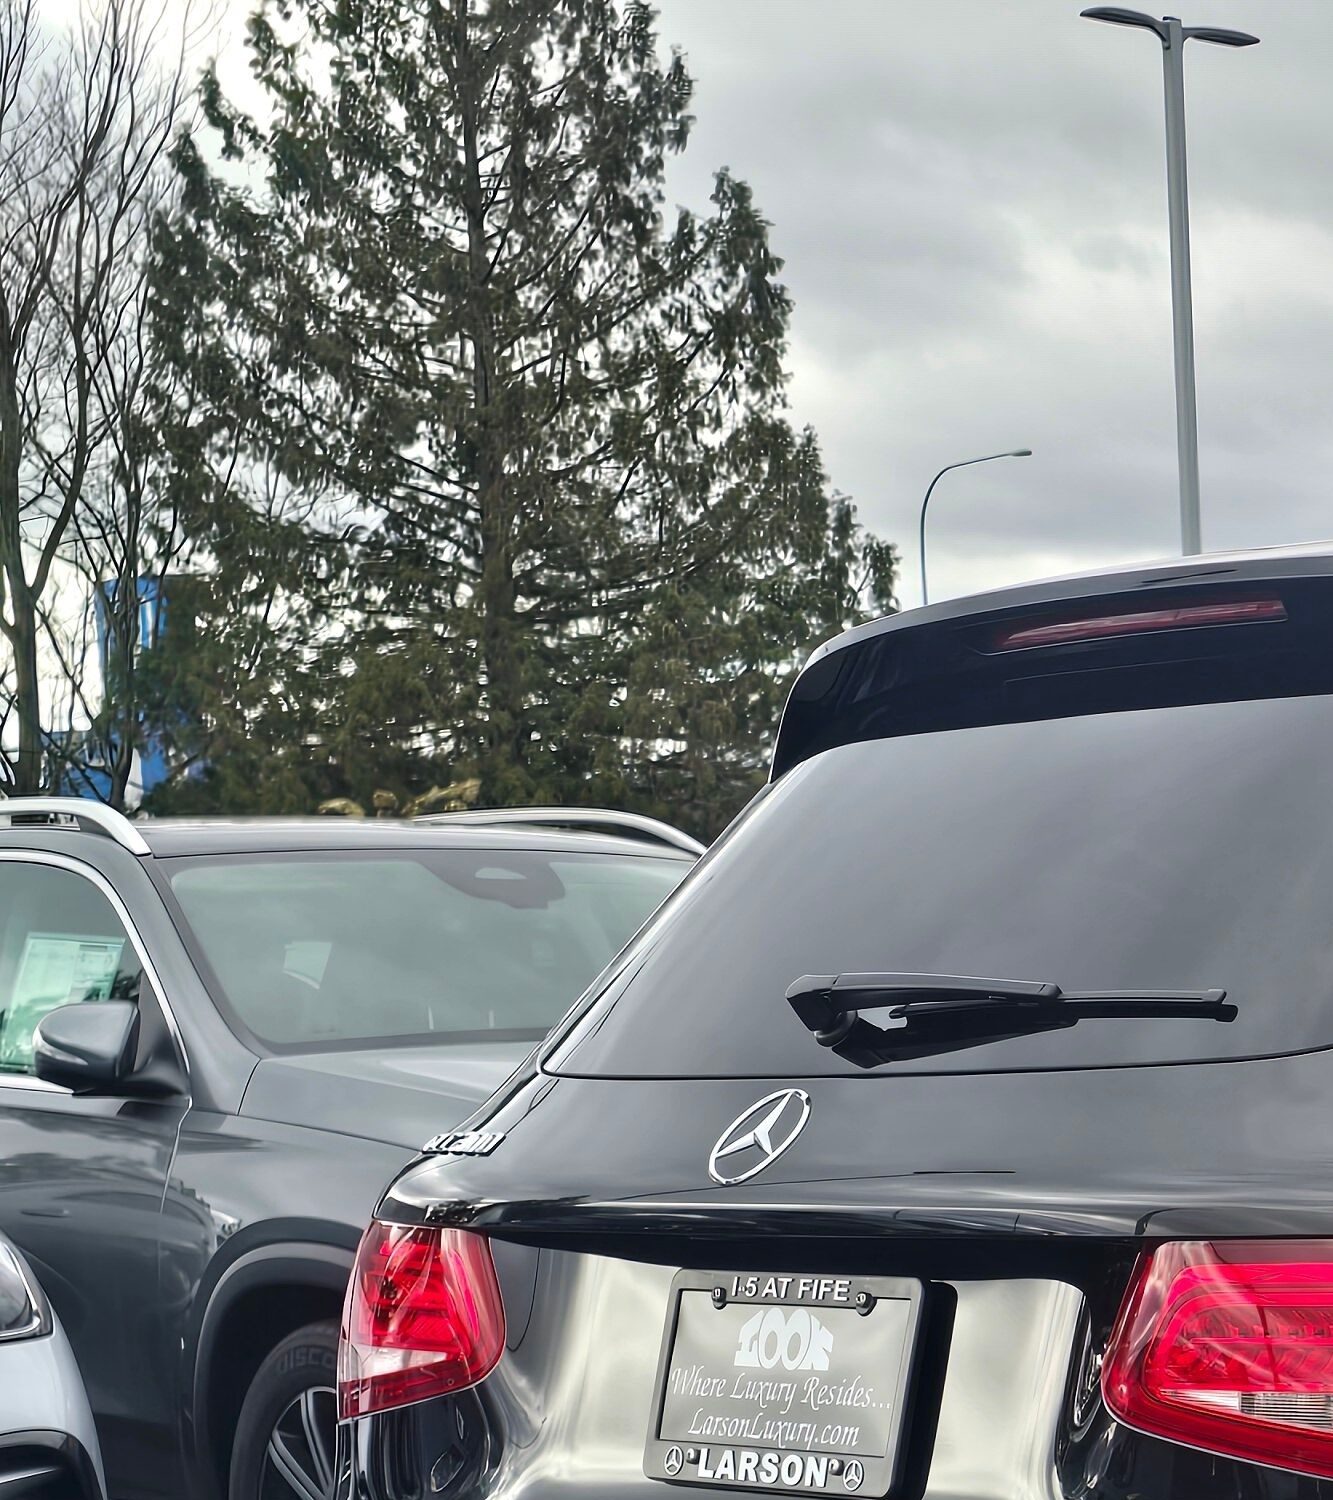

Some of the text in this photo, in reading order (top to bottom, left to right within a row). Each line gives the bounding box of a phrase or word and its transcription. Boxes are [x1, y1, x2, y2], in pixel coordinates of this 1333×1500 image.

[761, 1277, 793, 1299] AT
[797, 1278, 850, 1301] FIFE
[671, 1365, 891, 1414] Where Luxury Resides...
[688, 1408, 860, 1451] LarsonLuxury.com
[697, 1448, 828, 1488] LARSON
